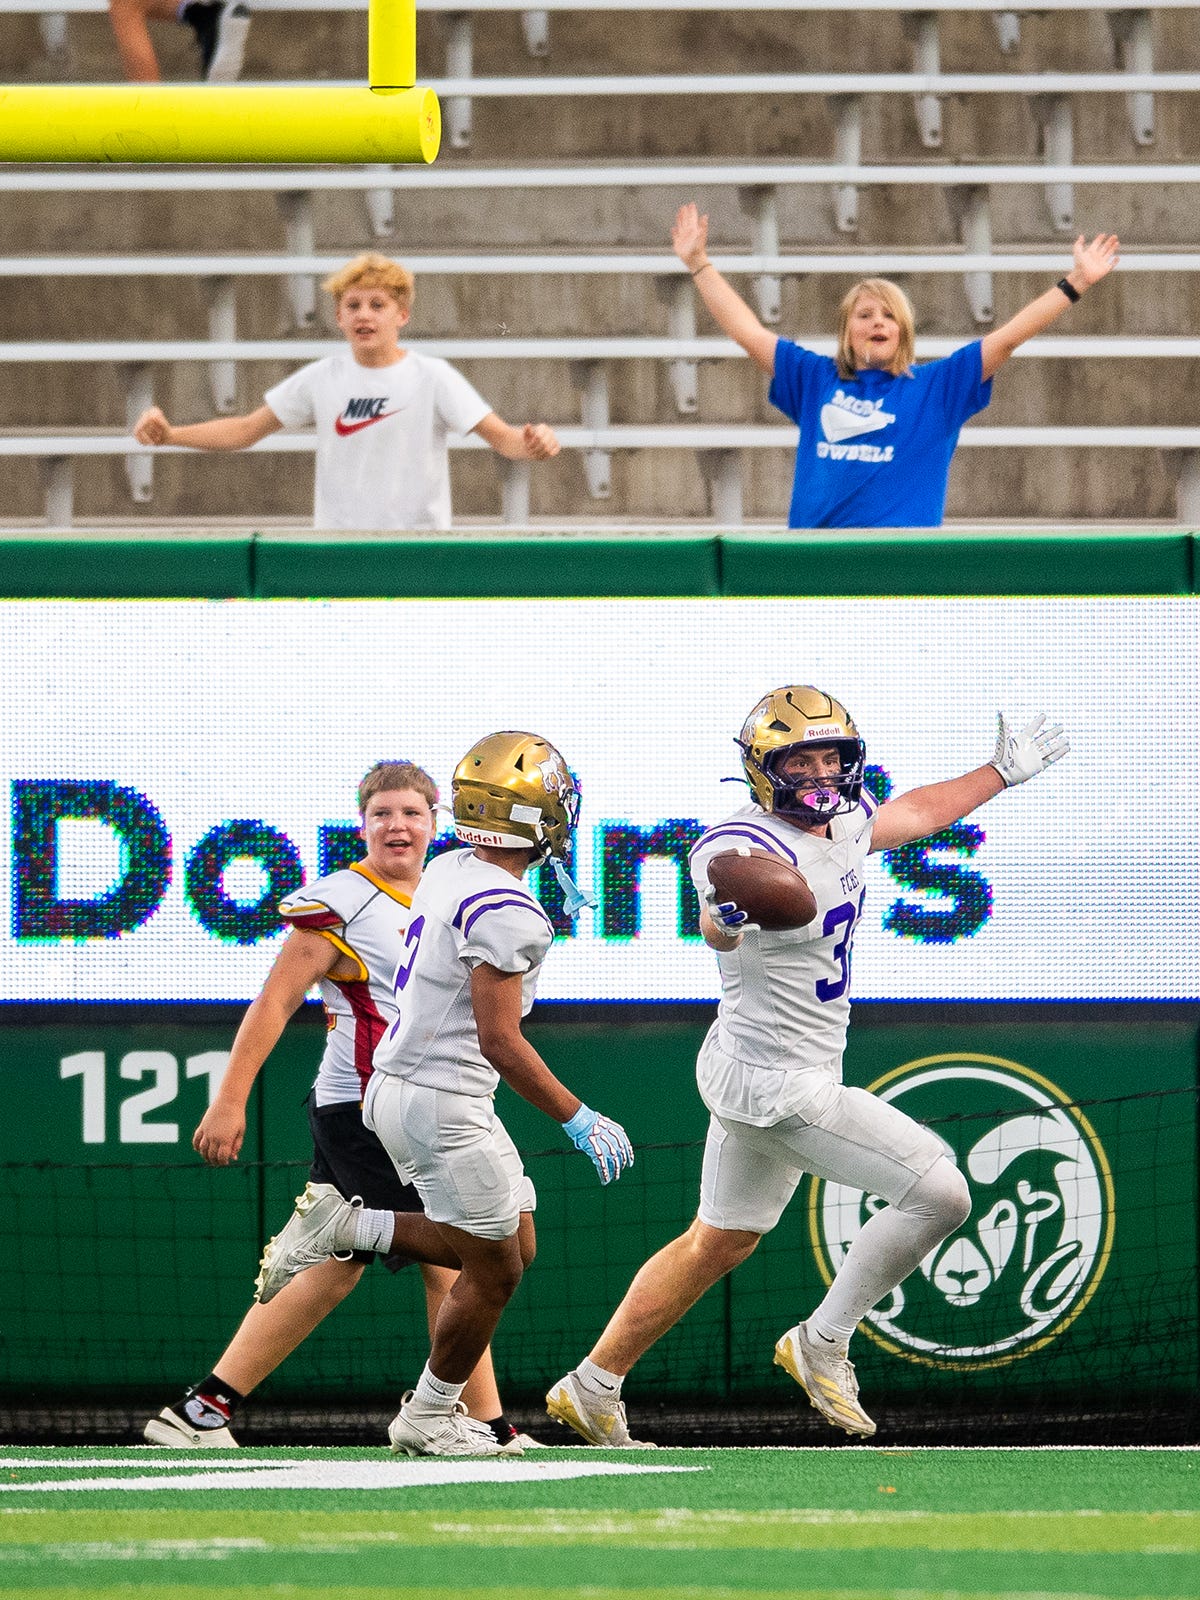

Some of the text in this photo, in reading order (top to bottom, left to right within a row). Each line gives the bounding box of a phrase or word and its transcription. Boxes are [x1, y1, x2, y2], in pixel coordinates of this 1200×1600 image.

[344, 397, 389, 418] NIKE
[808, 727, 841, 737] Riddell
[456, 828, 503, 845] Riddell
